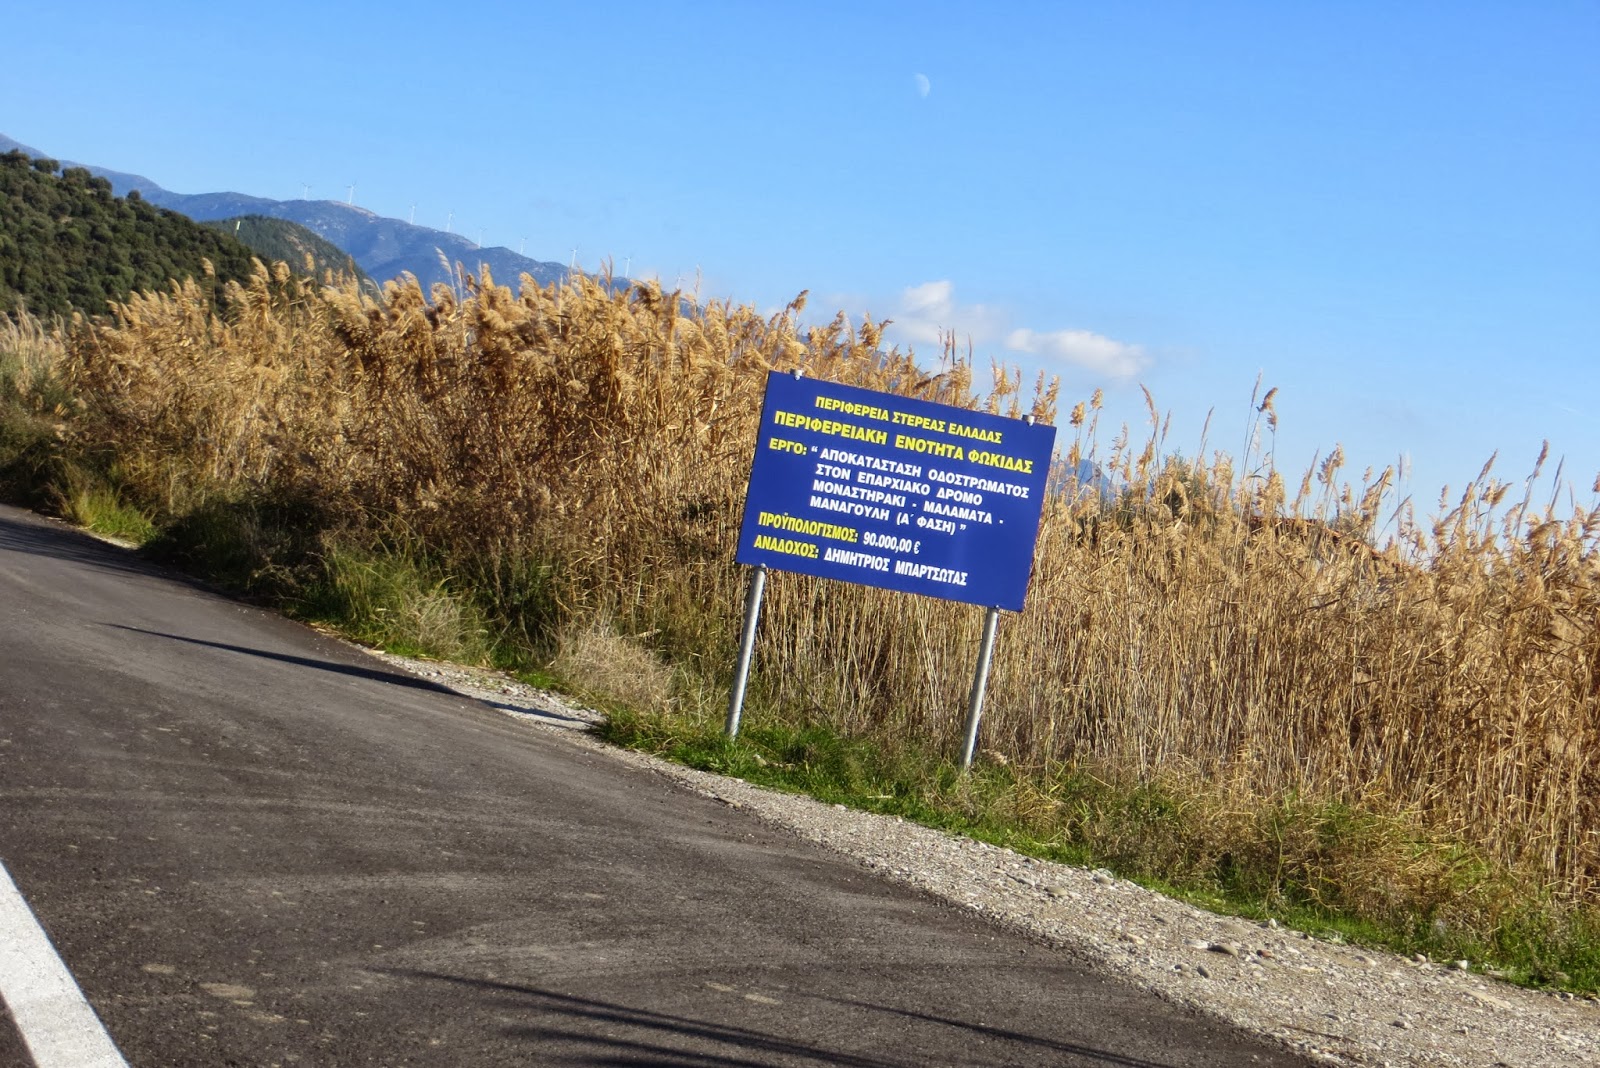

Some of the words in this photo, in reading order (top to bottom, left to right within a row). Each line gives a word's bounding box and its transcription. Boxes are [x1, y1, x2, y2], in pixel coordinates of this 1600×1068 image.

[774, 410, 888, 445] ΠΕΡΙΦΕΡΕΙΑΚΗ
[894, 434, 964, 460] ΕΝΟΤΗΤΑ
[968, 449, 1033, 474] ΦΩΚΙΔΑΣ
[815, 396, 889, 421] ΠΕΡΙΦΕΡΕΙΑ
[892, 411, 946, 433] ΣΤΕΡΕΑΣ
[948, 422, 1002, 444] ΕΛΛΑΔΑΣ
[769, 437, 807, 455] ΕΡΓΟ:
[819, 448, 922, 478] ΑΠΟΚΑΤΑΣΤΑΣΗ
[928, 469, 1030, 499] ΟΔΟΣΤΡΩΜΑΤΟΣ
[815, 463, 851, 480] ΣΤΟΝ
[857, 471, 931, 496] ΕΠΑΡΧΙΑΚΟ
[936, 487, 983, 506] ΔΡΟΜΟ
[810, 495, 890, 521] ΜΑΝΑΓΟΥΛΗ
[916, 516, 956, 536] ΦΑΣΗ)
[812, 479, 906, 507] ΜΟΝΑΣΤΗΡΑΚΙ
[923, 500, 992, 524] ΜΑΛΑΜΑΤΑ
[753, 534, 819, 559] ΑΝΑΔΟΧΟΣ:
[823, 547, 890, 572] ΔΗΜΗΤΡΙΟΣ
[894, 560, 968, 586] ΜΠΑΡΤΣΩΤΑΣ
[863, 531, 912, 553] 90.000,00
